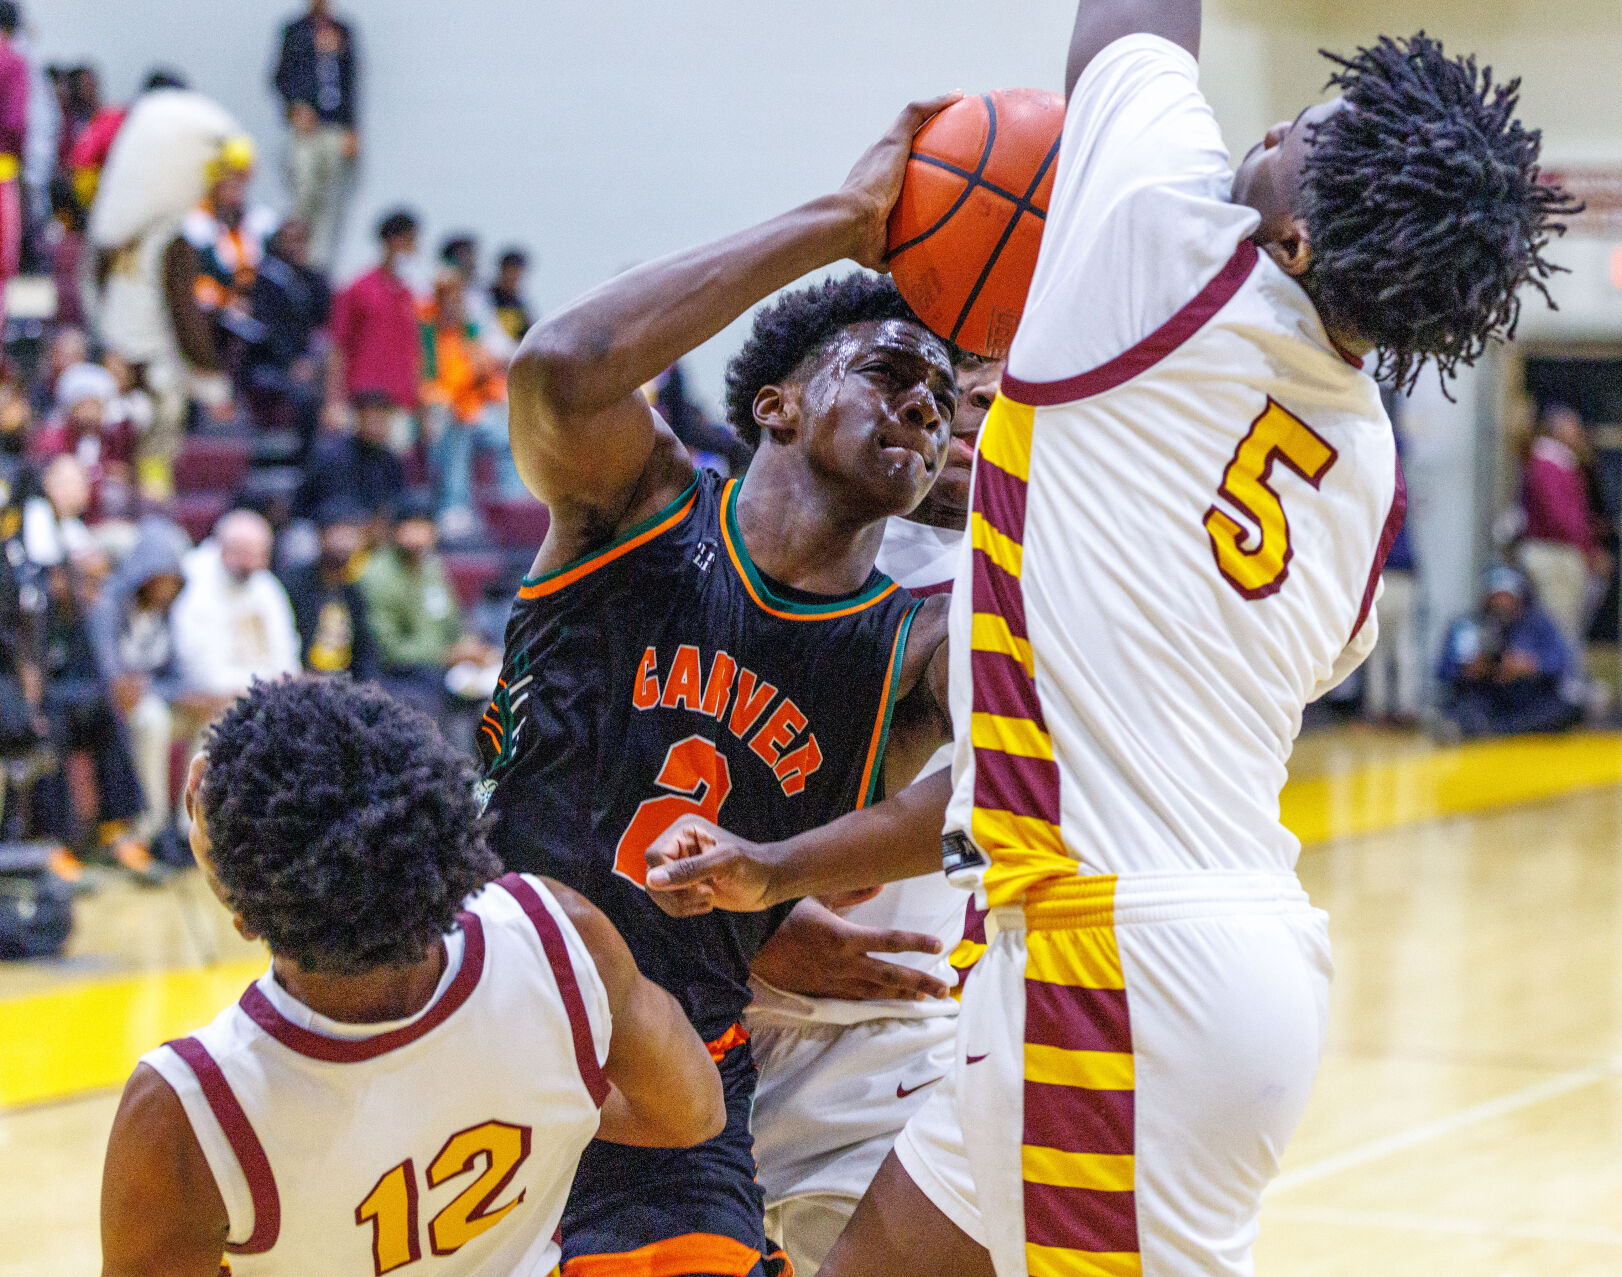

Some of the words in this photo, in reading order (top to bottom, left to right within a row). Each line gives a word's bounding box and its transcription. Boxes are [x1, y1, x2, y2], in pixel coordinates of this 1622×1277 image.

[1203, 394, 1338, 600] 5
[612, 734, 732, 890] 2
[355, 1118, 532, 1277] 12
